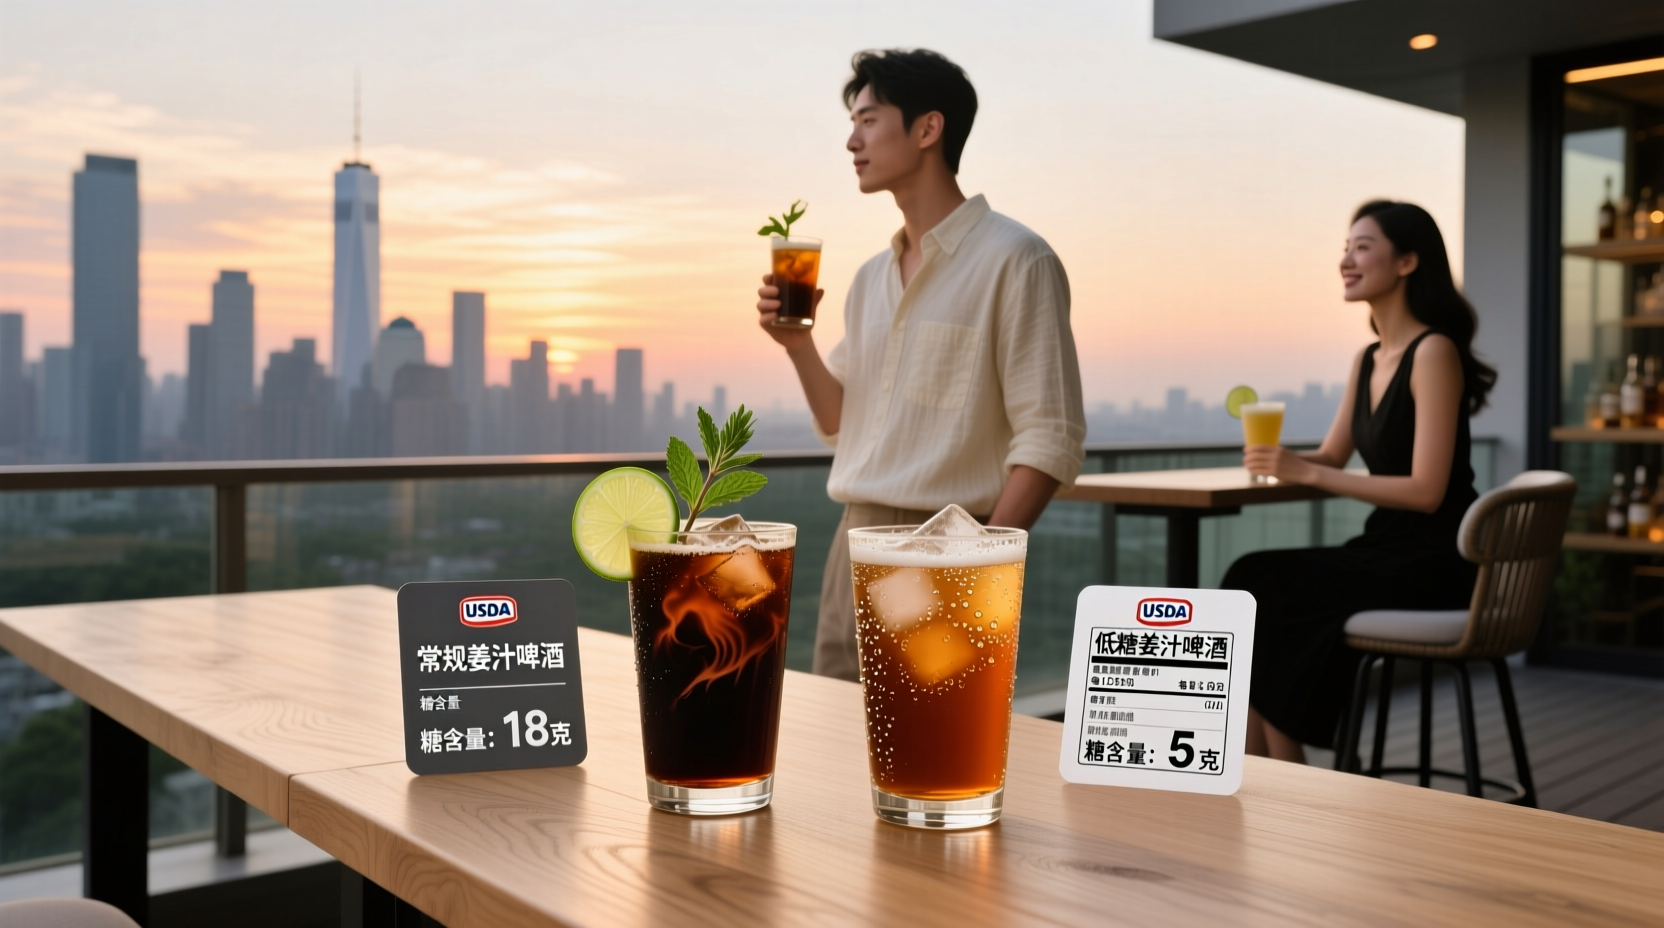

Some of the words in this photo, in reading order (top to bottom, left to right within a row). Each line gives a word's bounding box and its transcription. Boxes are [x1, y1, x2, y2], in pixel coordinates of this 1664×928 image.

[465, 602, 511, 618] USDA
[1143, 603, 1187, 618] USDA
[1095, 631, 1228, 660] 低糖姜汁啤酒
[417, 642, 565, 673] 常规姜汁啤酒
